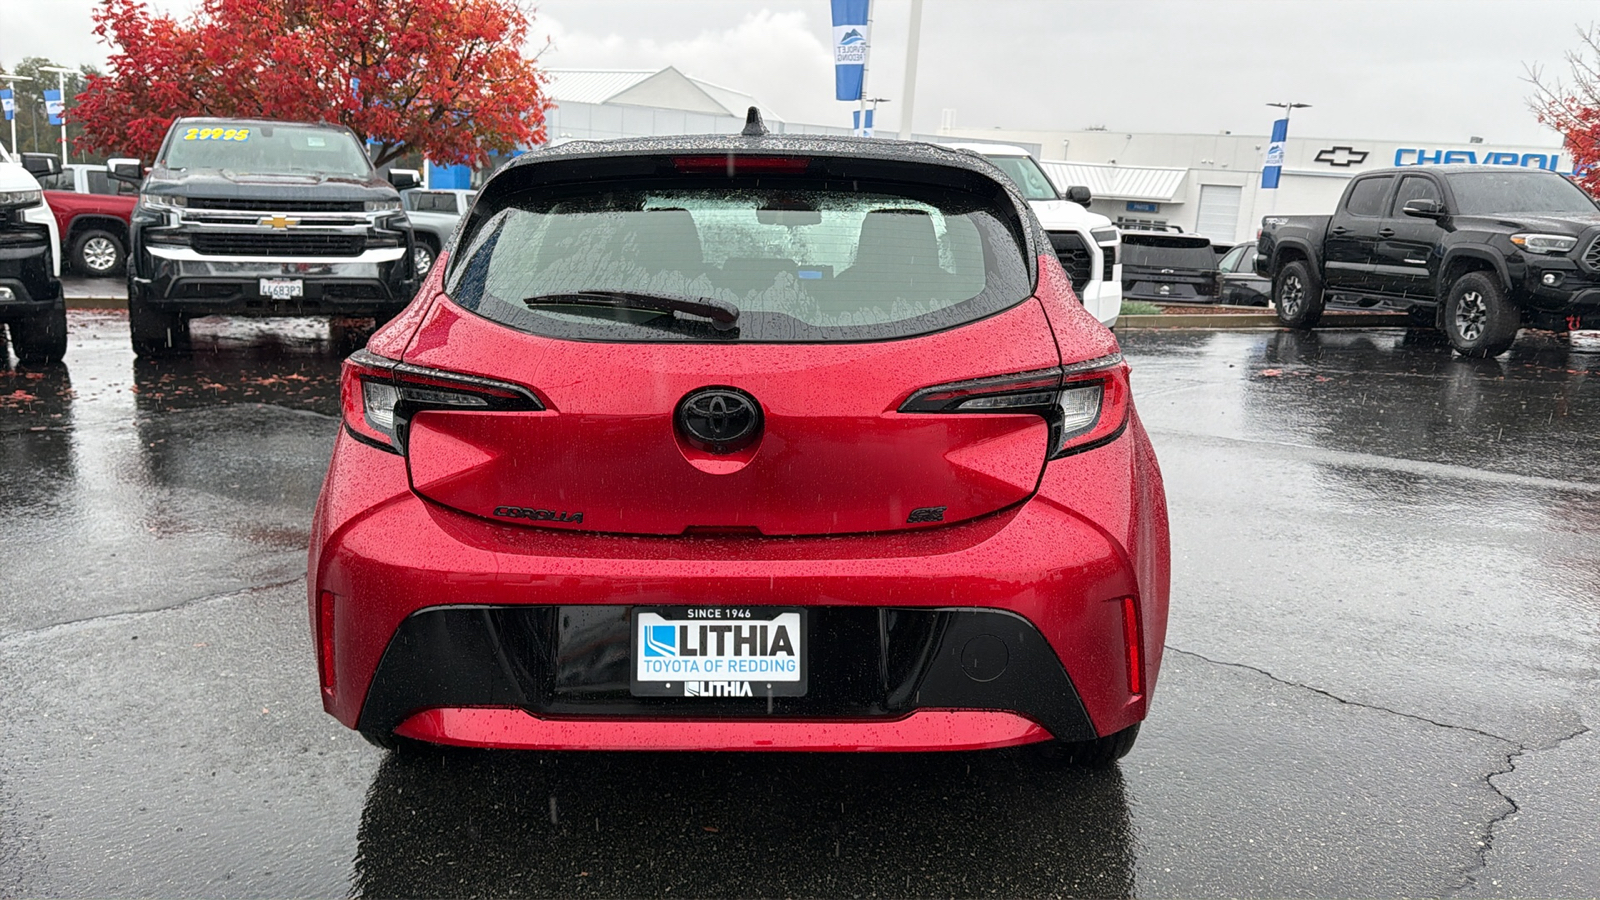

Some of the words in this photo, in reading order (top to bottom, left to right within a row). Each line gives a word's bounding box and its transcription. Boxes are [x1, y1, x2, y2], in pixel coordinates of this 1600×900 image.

[184, 127, 249, 141] 29995
[493, 505, 583, 524] COROLLA
[687, 608, 721, 618] SINCE
[725, 608, 751, 618] 1946
[679, 625, 795, 656] LITHIA
[644, 659, 699, 673] TOYOTA
[703, 659, 723, 673] OF
[728, 659, 796, 673] REDDING
[700, 681, 753, 697] LITHIA
